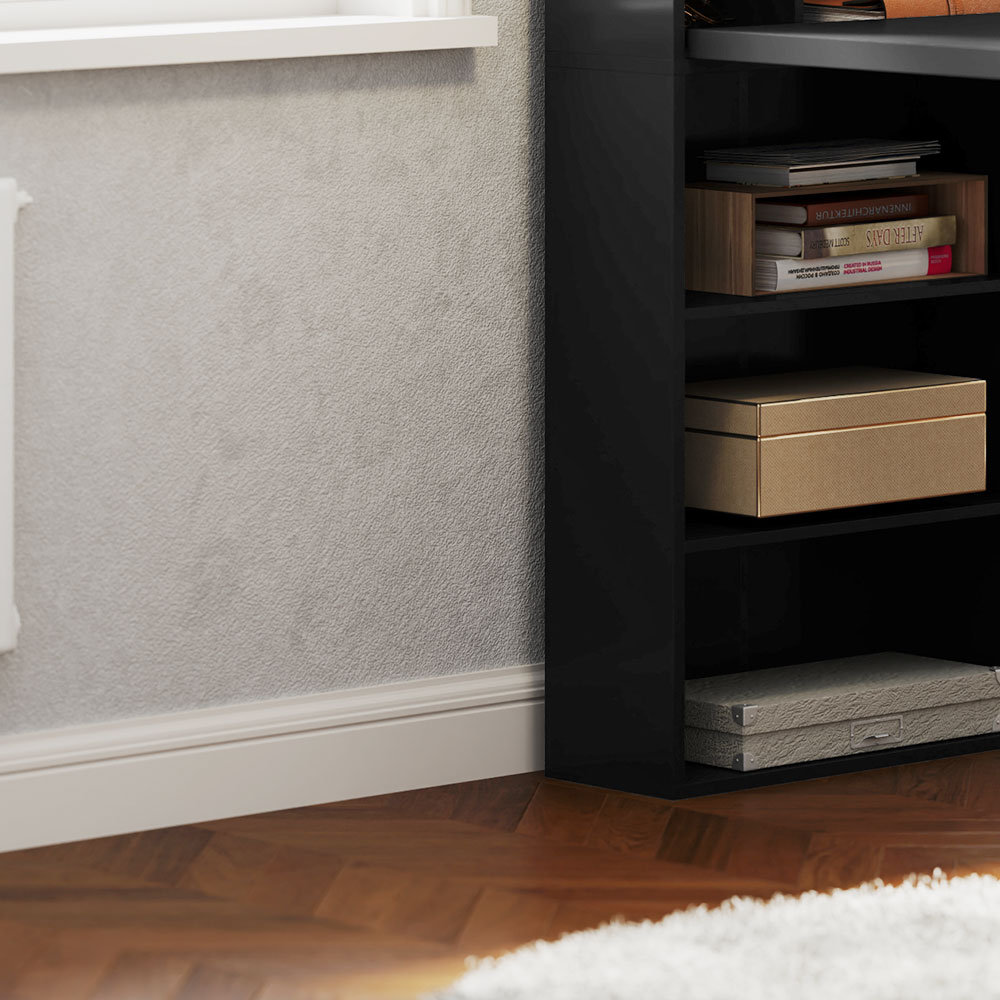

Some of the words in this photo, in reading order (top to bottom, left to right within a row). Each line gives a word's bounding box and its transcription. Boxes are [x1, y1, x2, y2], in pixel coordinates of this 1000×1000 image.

[815, 202, 912, 221] INNENARCHITEKTUR
[833, 236, 850, 247] SCOTT
[866, 229, 891, 248] DAYS
[894, 225, 924, 245] AFTER
[843, 267, 867, 275] INDUSTRIAL
